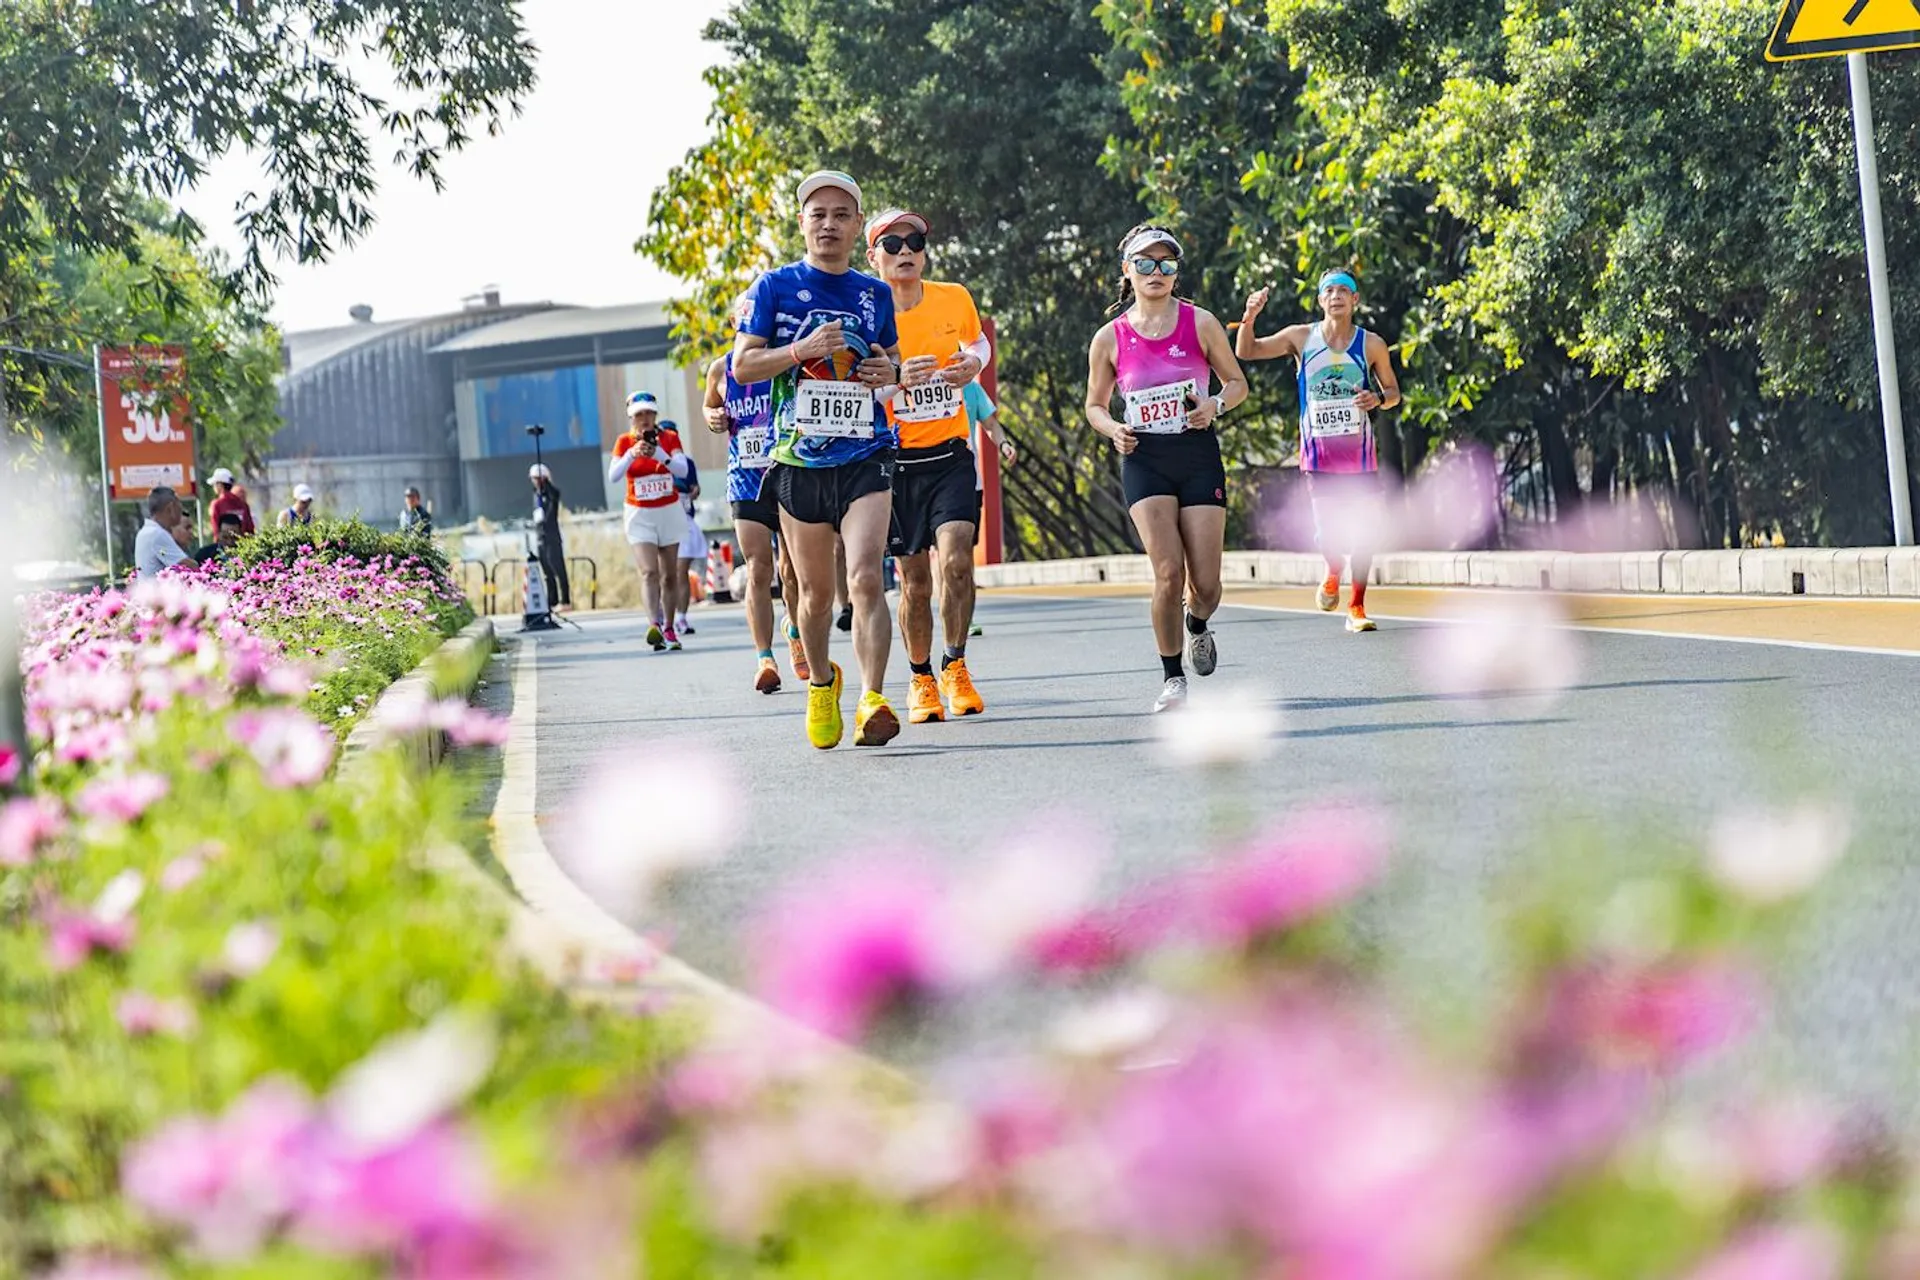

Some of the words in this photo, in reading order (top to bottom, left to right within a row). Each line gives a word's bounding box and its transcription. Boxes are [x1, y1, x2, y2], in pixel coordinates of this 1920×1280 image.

[728, 394, 769, 418] MARAT
[811, 398, 862, 419] B1687
[1140, 400, 1187, 423] B237
[1316, 409, 1351, 424] A0549
